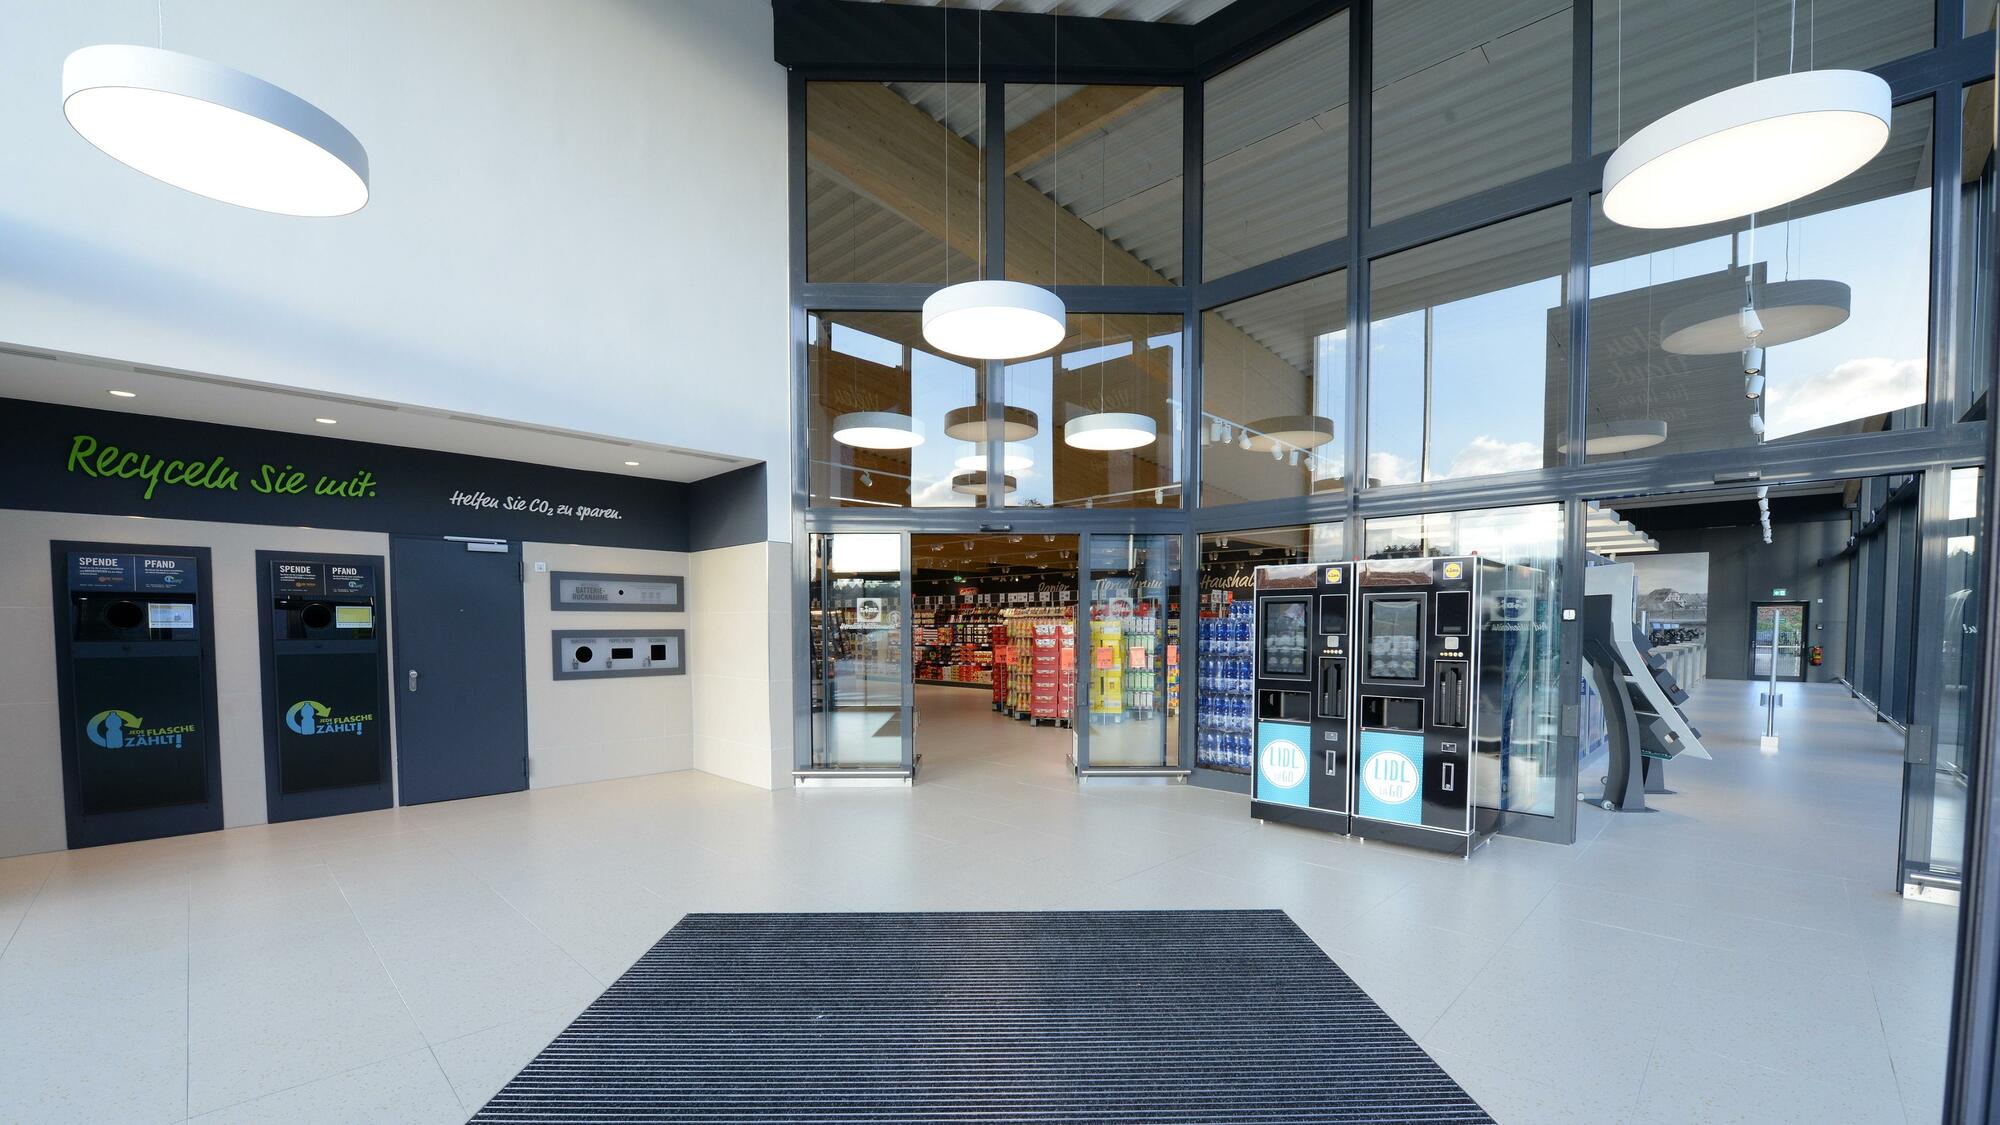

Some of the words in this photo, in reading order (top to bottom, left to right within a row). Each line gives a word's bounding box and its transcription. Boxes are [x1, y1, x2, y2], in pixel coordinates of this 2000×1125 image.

[67, 435, 239, 500] Recyceln
[251, 464, 308, 494] Sie
[314, 470, 377, 498] mit.
[449, 490, 499, 510] Helfen
[503, 496, 527, 511] Sie
[556, 504, 574, 516] zu
[576, 505, 623, 521] sparen.
[79, 557, 118, 567] SPENDE
[144, 559, 176, 569] PFAND
[279, 565, 312, 574] SPENDE
[332, 567, 357, 576] PFAND
[333, 714, 374, 724] FLASCHE
[147, 724, 196, 736] FLASCHE
[316, 721, 363, 736] ZÄHLT!
[125, 734, 182, 749] ZÄHLT!
[1270, 746, 1300, 769] LIDL
[1374, 758, 1410, 783] LIDL
